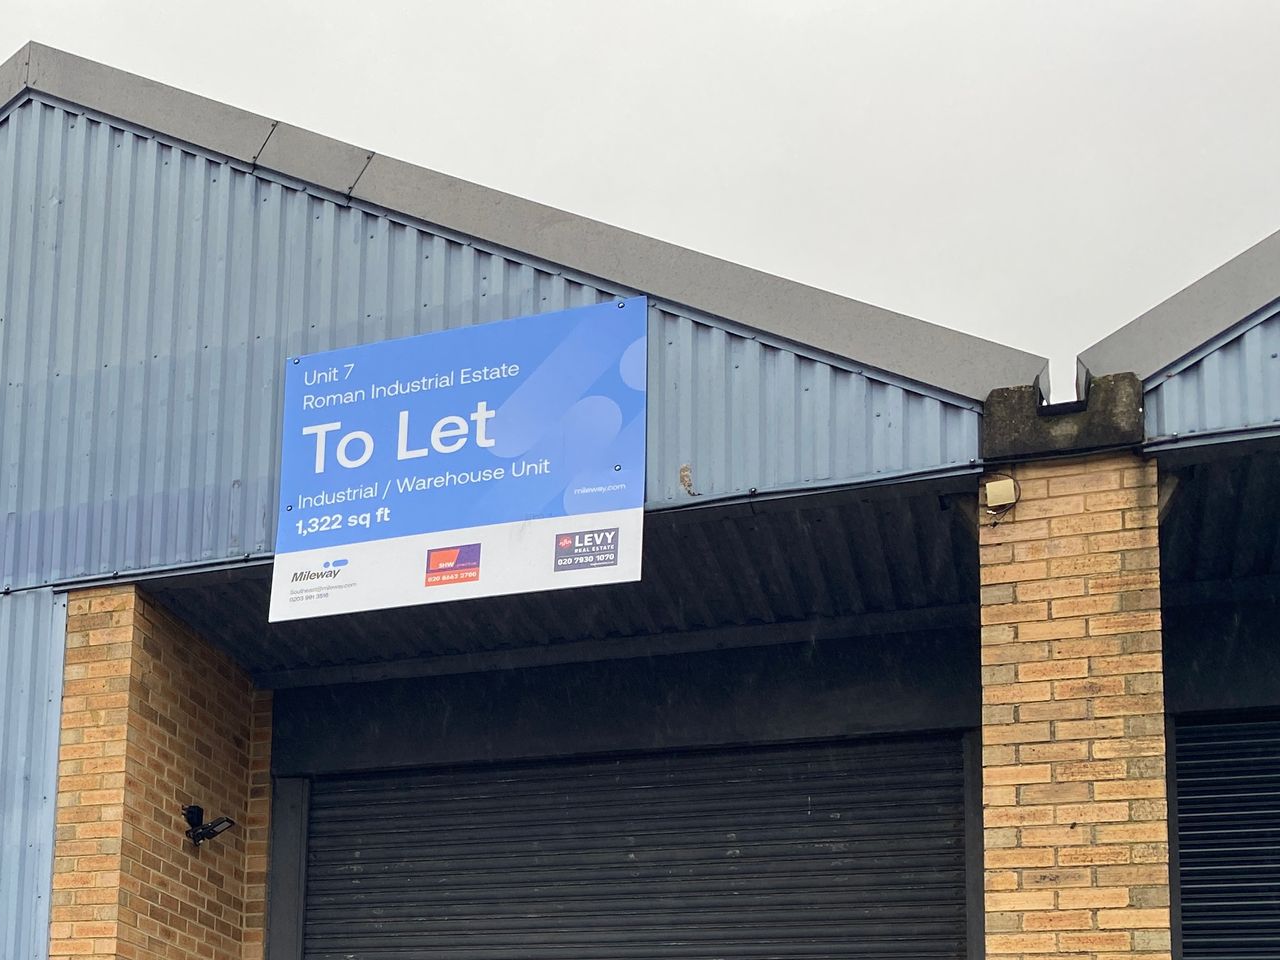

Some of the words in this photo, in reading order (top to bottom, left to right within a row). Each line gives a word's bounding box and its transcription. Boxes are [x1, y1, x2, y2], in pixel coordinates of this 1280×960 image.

[303, 389, 365, 410] Roman
[371, 372, 454, 398] Industrial
[460, 363, 520, 384] Estate
[304, 370, 338, 386] Unit
[343, 364, 355, 379] 7
[302, 421, 375, 474] To
[397, 401, 496, 461] Let
[297, 482, 378, 509] Industrial
[381, 480, 391, 500] /
[396, 467, 505, 494] Warehouse
[511, 458, 551, 478] Unit
[295, 513, 343, 535] 1,322
[347, 511, 371, 528] sq
[375, 507, 391, 522] ft
[575, 531, 616, 547] LEVY
[557, 558, 573, 566] 020
[596, 553, 615, 561] 1070
[291, 569, 341, 582] Mileway
